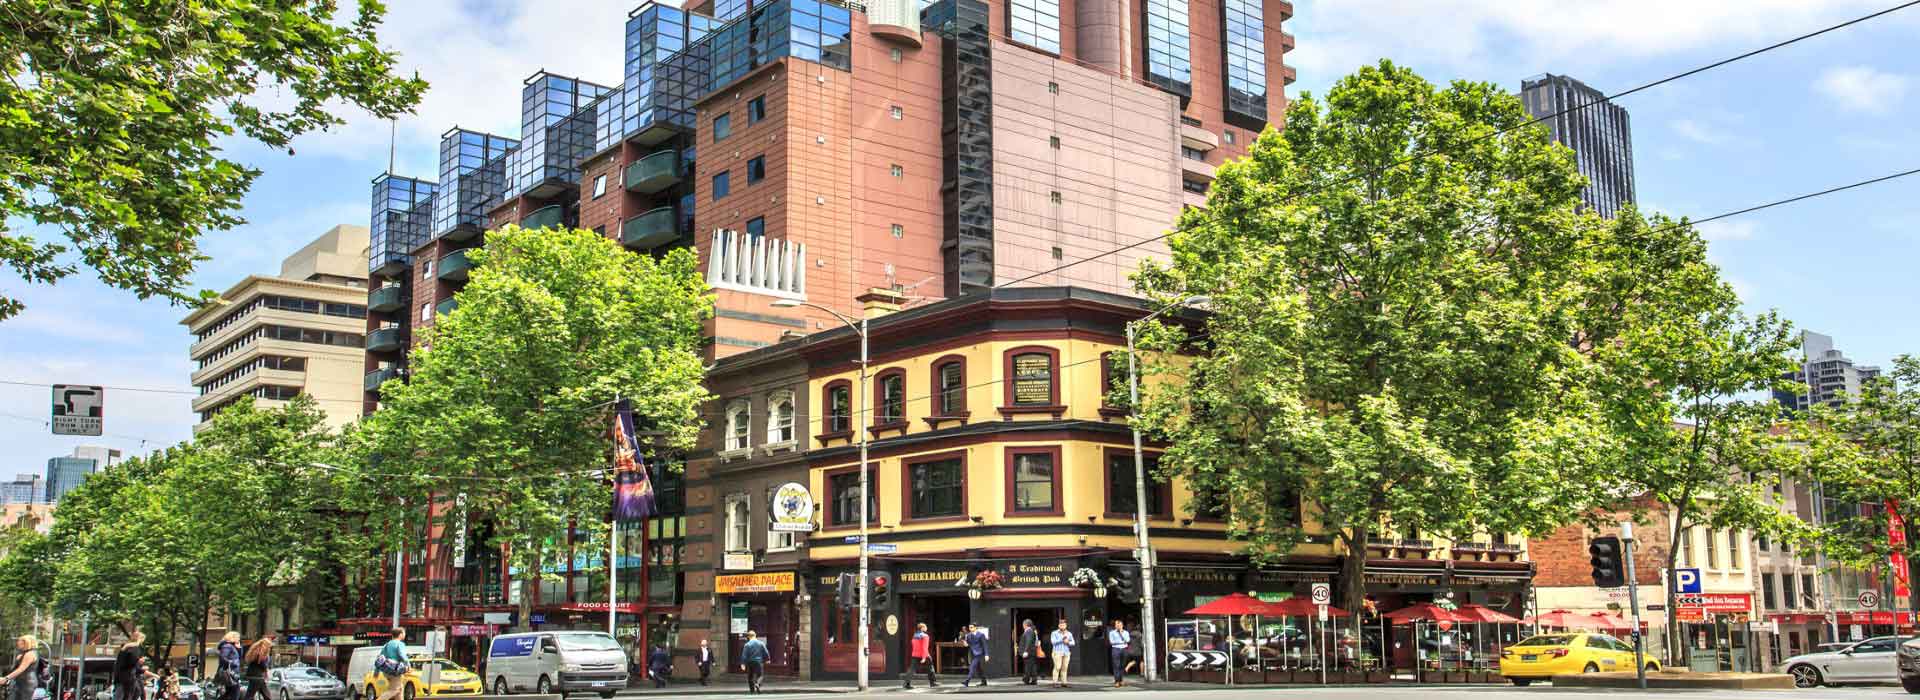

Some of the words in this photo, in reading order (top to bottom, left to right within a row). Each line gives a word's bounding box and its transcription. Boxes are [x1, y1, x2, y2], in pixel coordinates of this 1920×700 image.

[761, 573, 793, 585] PALACE
[1676, 571, 1696, 592] P
[1315, 590, 1327, 598] 40
[1862, 596, 1874, 604] 40
